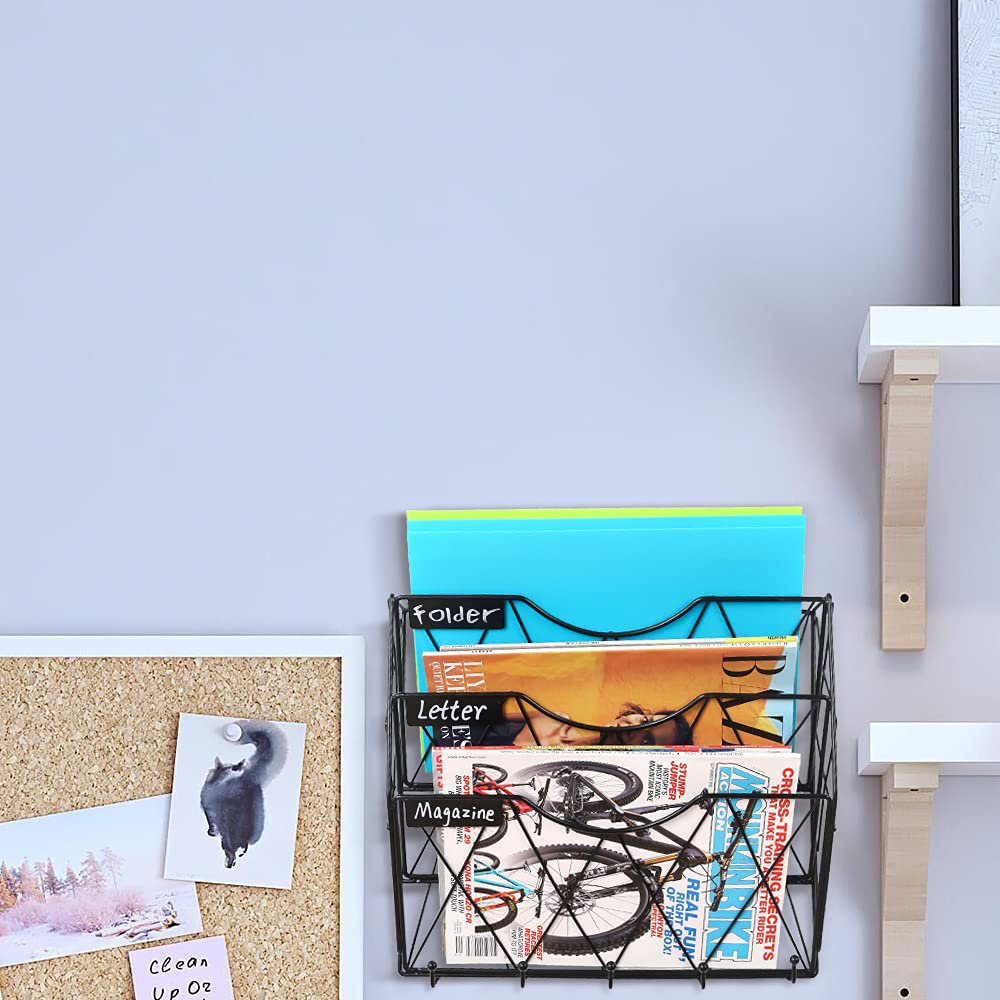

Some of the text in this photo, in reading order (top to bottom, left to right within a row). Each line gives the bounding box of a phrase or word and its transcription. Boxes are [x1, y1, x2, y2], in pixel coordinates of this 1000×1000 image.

[417, 699, 488, 721] Letter
[668, 761, 679, 801] JUMPER
[677, 762, 688, 799] STUMP-
[414, 801, 495, 826] Magazine
[716, 771, 729, 832] ACION
[766, 812, 777, 841] MAKE
[764, 844, 773, 864] YOU
[666, 887, 676, 902] OF
[675, 892, 685, 926] RIGHT
[679, 878, 700, 962] REAL FUN,
[706, 888, 756, 960] BIKE
[755, 916, 766, 944] RIDER
[763, 896, 780, 961] SECRETS
[663, 929, 673, 955] BOX!
[149, 956, 208, 975] Clean
